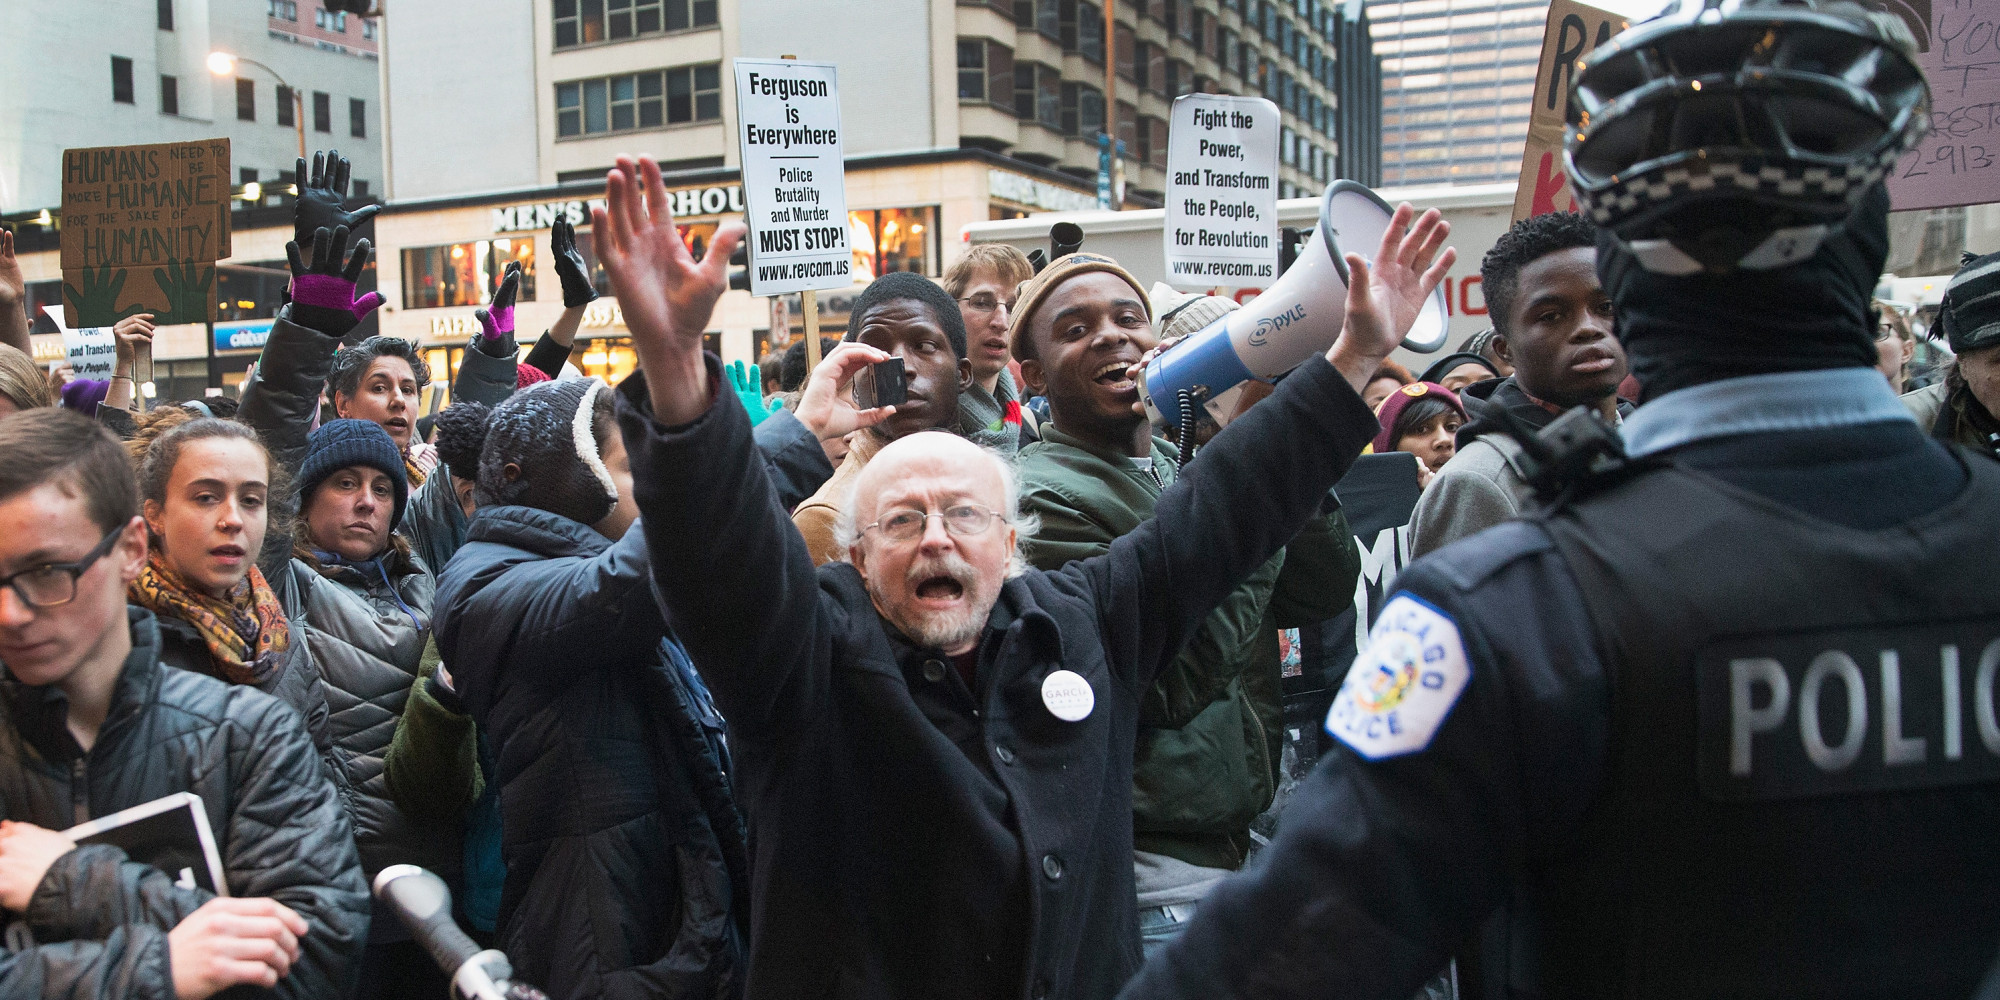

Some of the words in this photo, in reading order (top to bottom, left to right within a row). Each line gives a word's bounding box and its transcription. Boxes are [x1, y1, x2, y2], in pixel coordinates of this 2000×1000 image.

[1938, 13, 2000, 63] YO
[749, 73, 827, 100] Ferguson
[786, 104, 799, 124] is
[1194, 108, 1227, 130] Fight
[1231, 111, 1253, 129] the
[747, 124, 837, 149] Everywhere
[1200, 139, 1244, 161] Power,
[68, 149, 160, 184] HUMANS
[170, 146, 204, 160] NEED
[210, 145, 226, 158] TO
[189, 162, 203, 174] BE
[779, 168, 812, 183] Police
[1175, 169, 1199, 185] and
[1204, 170, 1269, 189] Transform
[67, 191, 100, 203] MORE
[107, 175, 218, 209] HUMANE
[775, 187, 820, 204] Brutality
[67, 215, 88, 227] FOR
[95, 212, 118, 224] THE
[128, 210, 160, 221] SAKE
[493, 201, 584, 233] MEN'S
[771, 209, 790, 223] and
[793, 207, 829, 222] Murder
[1184, 199, 1205, 216] the
[1210, 200, 1260, 221] People,
[760, 229, 800, 252] MUST
[804, 227, 845, 250] STOP!
[1176, 228, 1194, 245] for
[1199, 229, 1268, 248] Revolution
[759, 259, 849, 282] www.revcom.us
[1173, 261, 1272, 277] www.revcom.us
[70, 348, 83, 357] and
